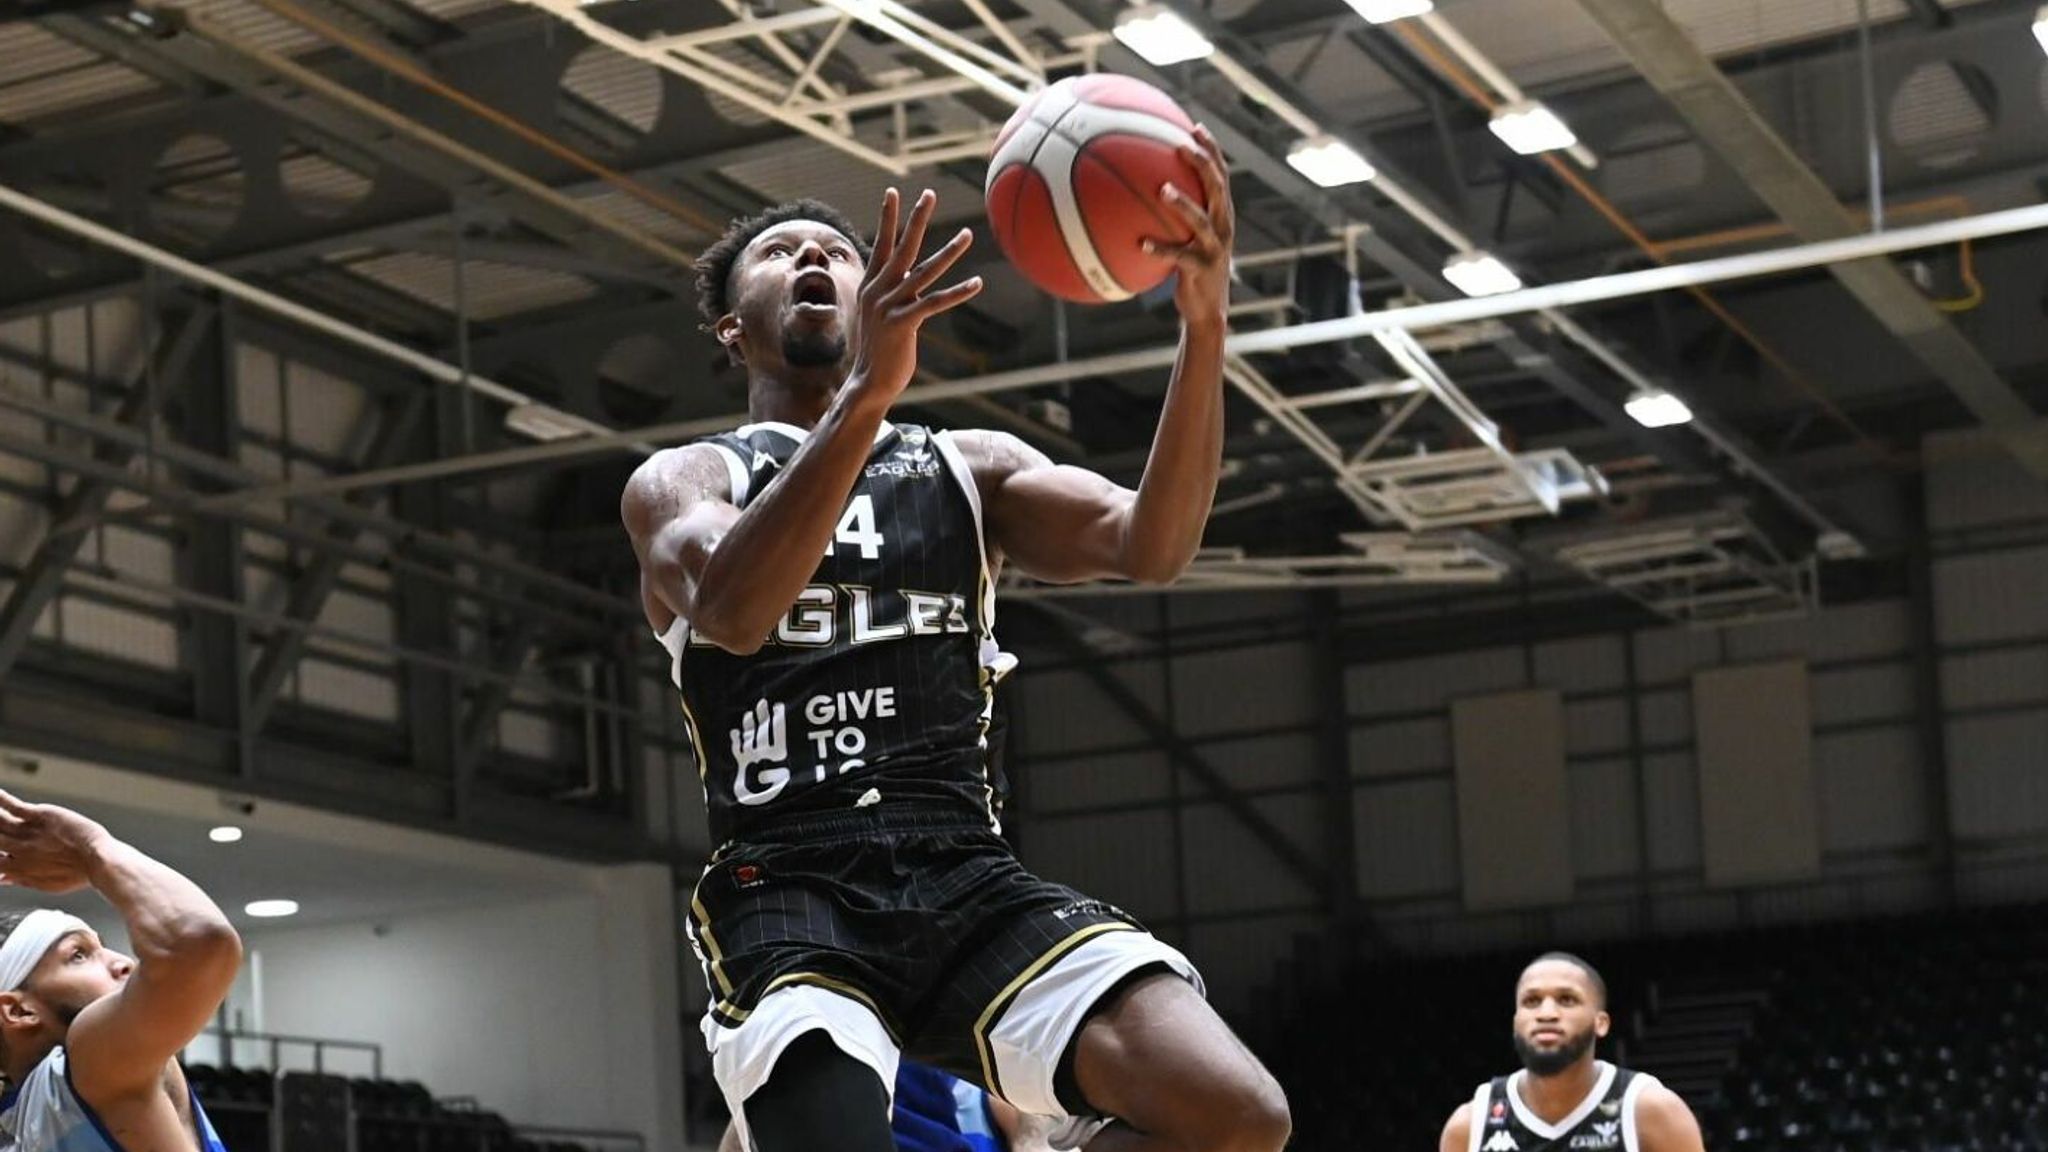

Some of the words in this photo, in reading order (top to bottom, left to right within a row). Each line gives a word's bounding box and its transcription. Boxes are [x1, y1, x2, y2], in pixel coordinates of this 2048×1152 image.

[824, 494, 885, 559] 4
[689, 584, 970, 648] GLES
[805, 687, 896, 725] GIVE
[808, 726, 866, 759] TO
